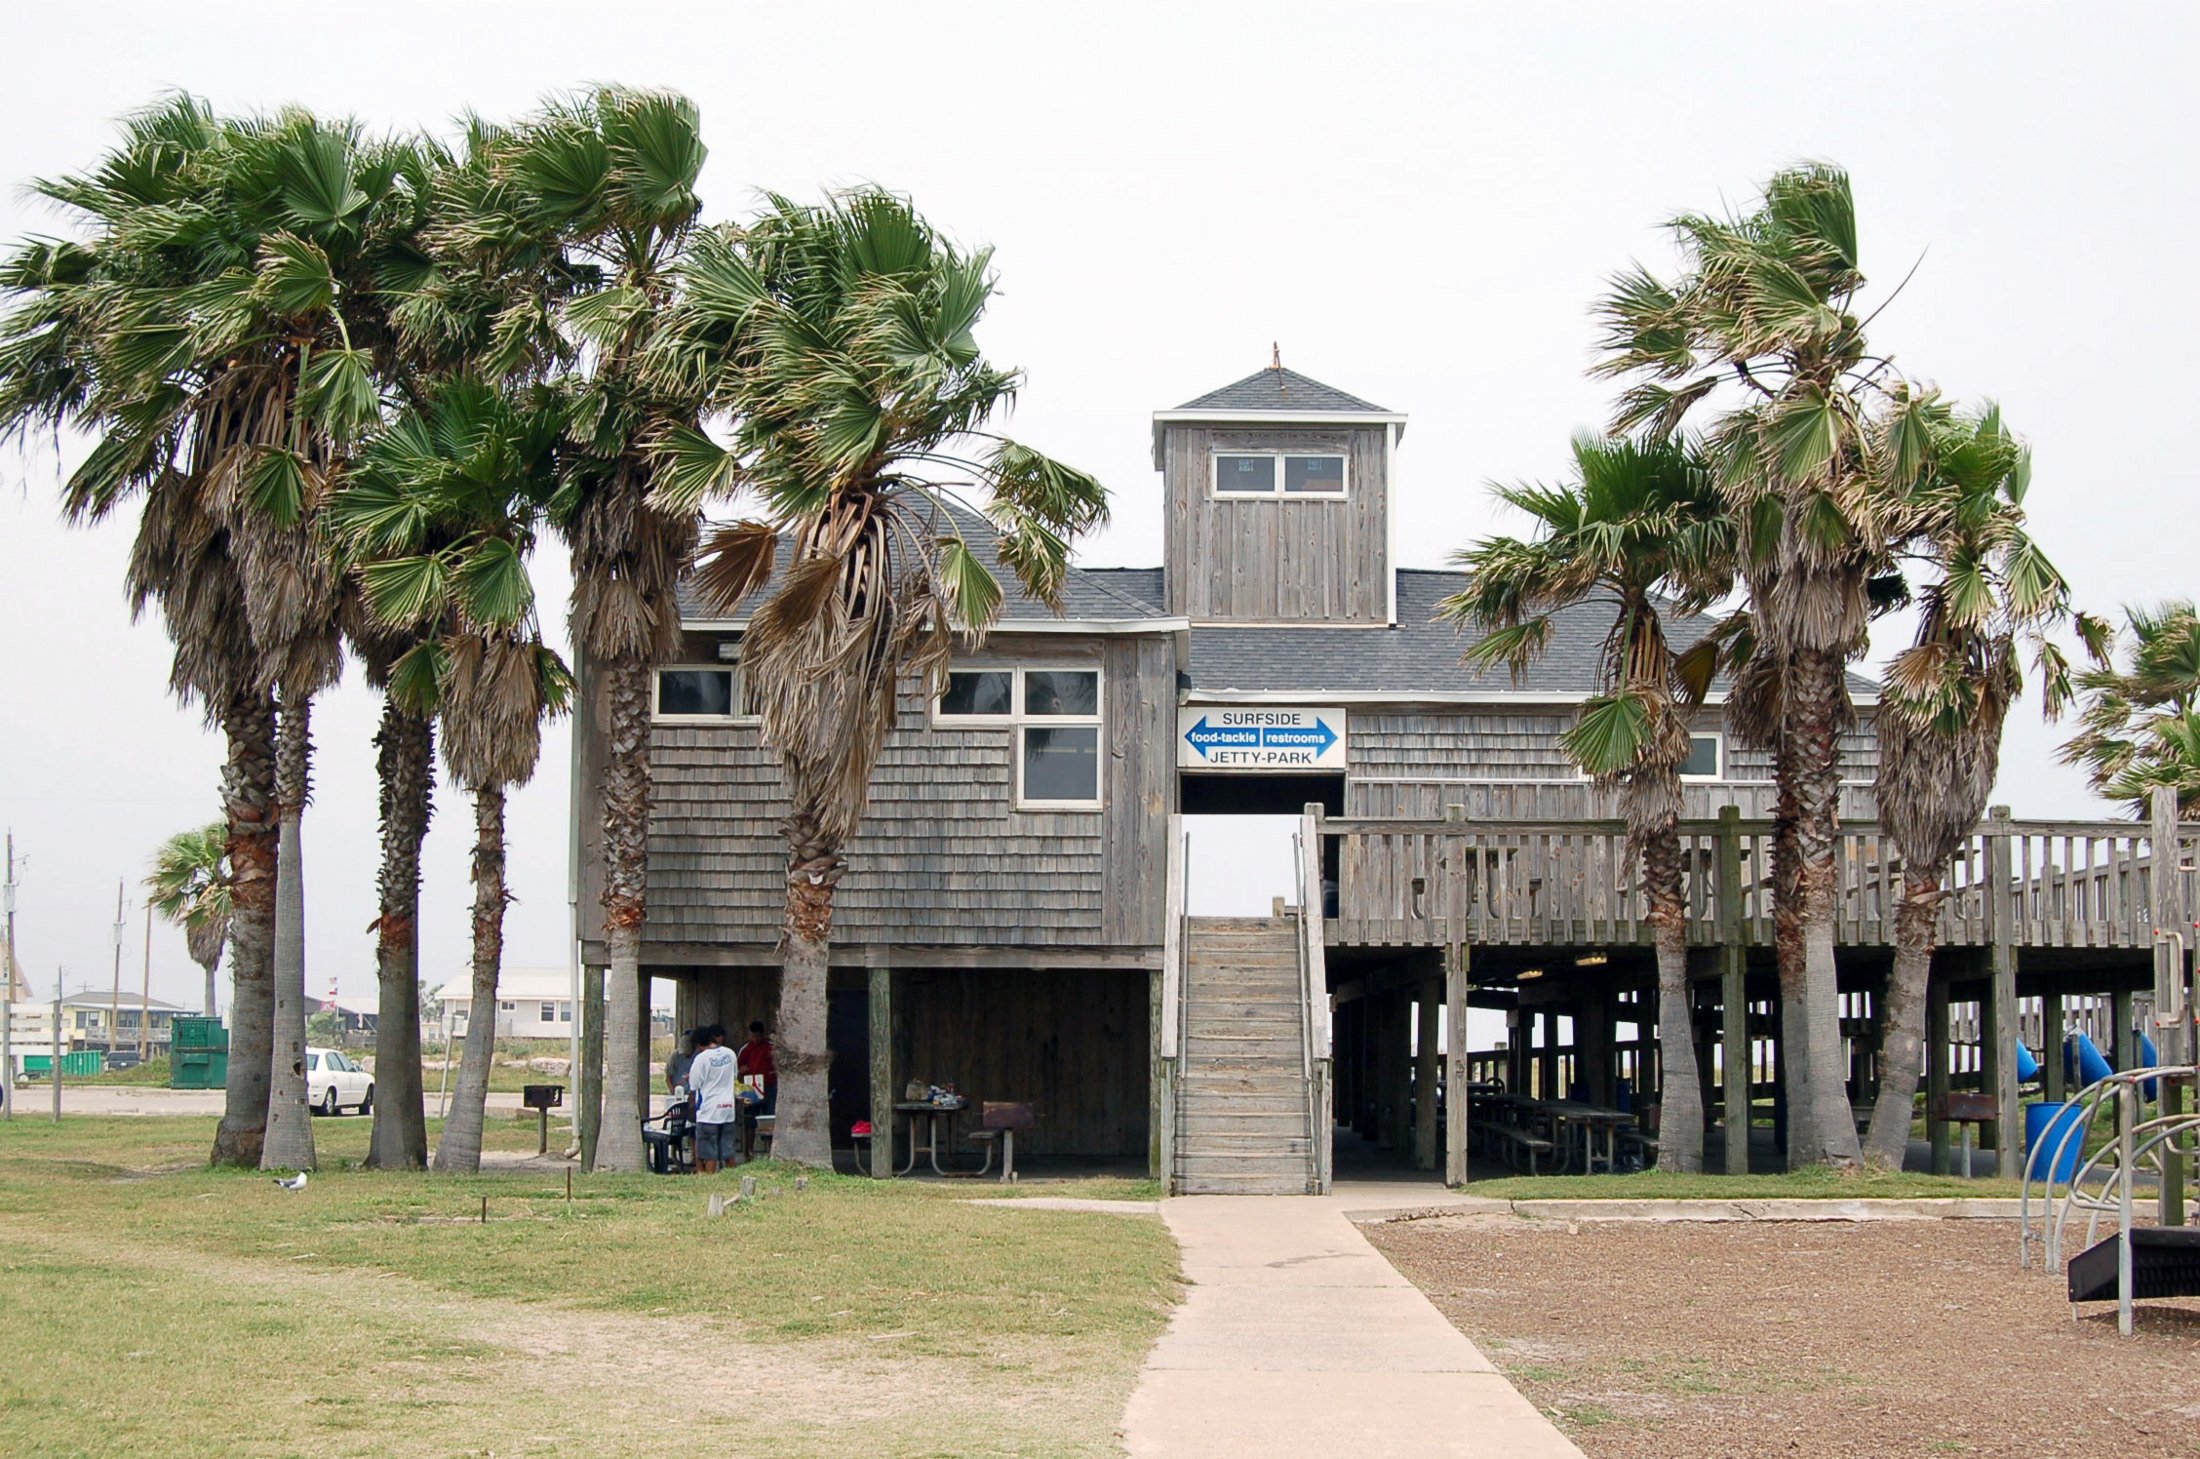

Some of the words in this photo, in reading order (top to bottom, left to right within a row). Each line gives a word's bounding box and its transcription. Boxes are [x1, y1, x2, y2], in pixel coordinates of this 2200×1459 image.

[1222, 712, 1301, 725] SURFSIDE
[1191, 732, 1257, 744] food-tackle
[1266, 733, 1326, 744] restrooms
[1210, 751, 1312, 764] JETTY-PARK
